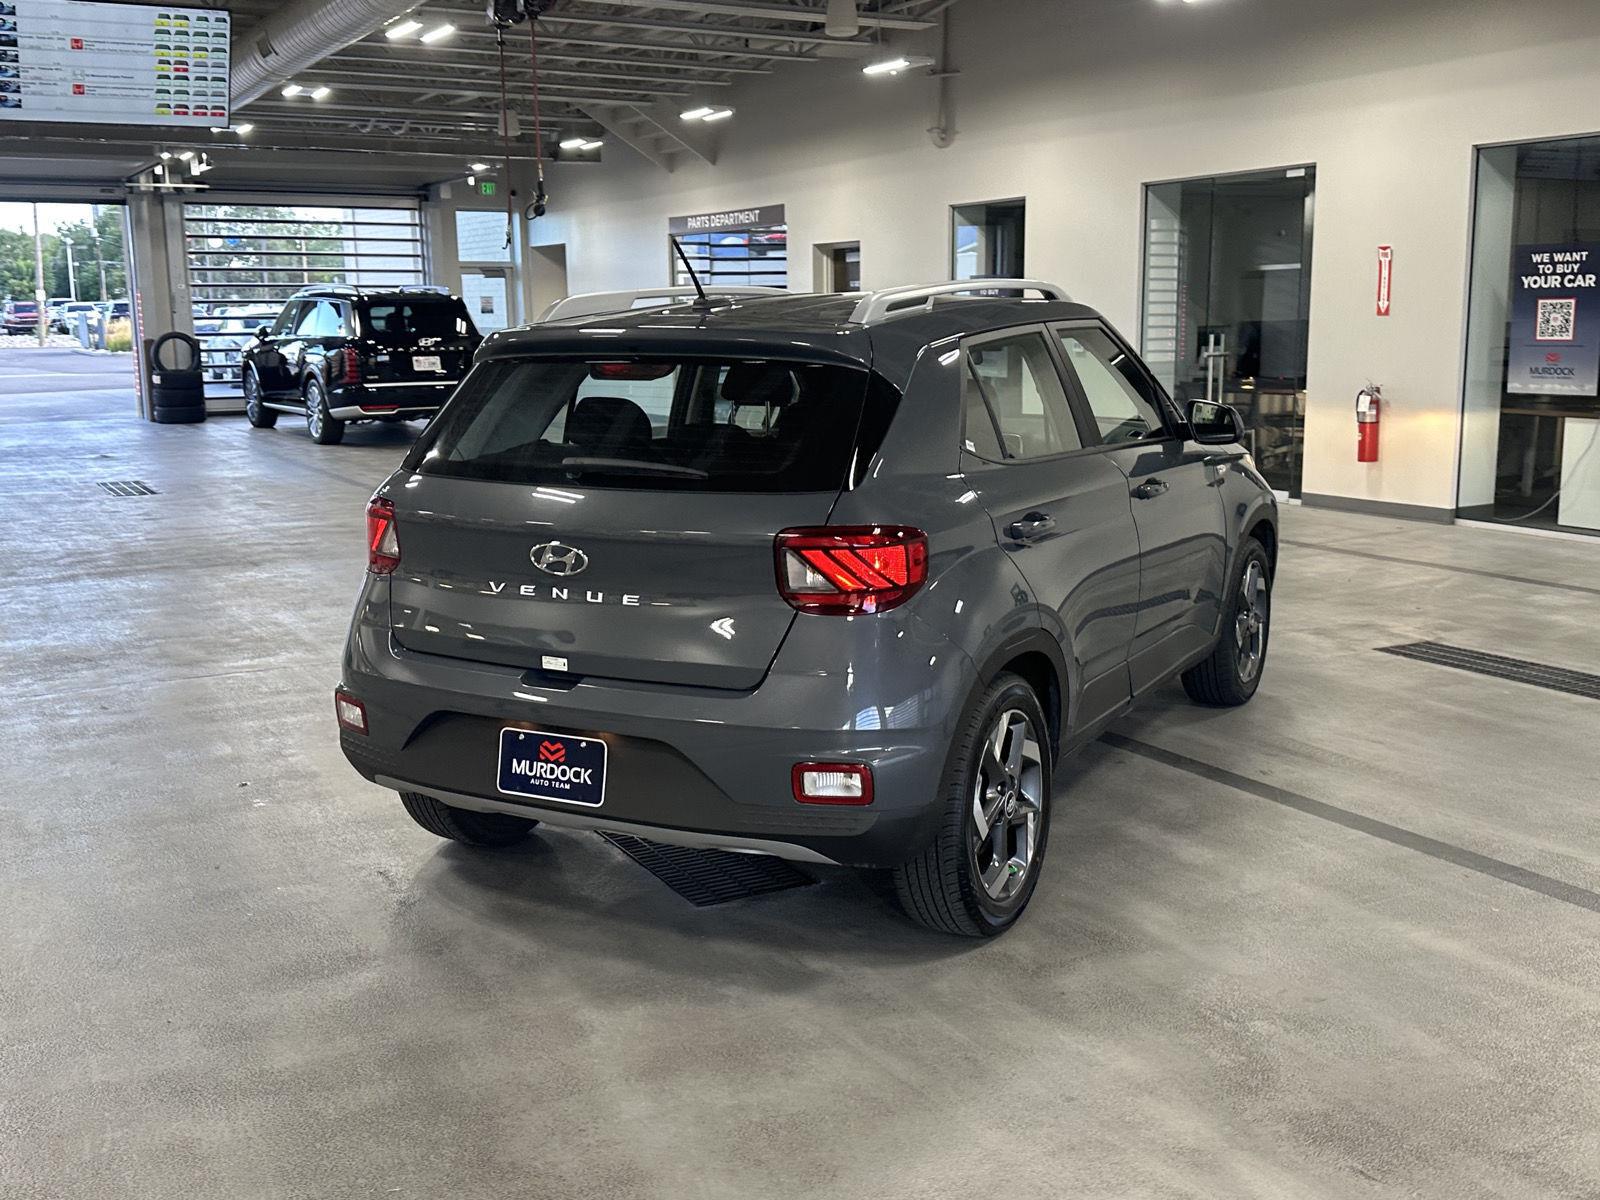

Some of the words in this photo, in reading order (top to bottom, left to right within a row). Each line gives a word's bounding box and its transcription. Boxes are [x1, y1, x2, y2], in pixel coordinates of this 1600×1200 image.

[481, 182, 496, 195] EXIT
[687, 215, 710, 229] PARTS
[710, 209, 760, 227] DEPARTMENT
[1531, 253, 1550, 263] WE
[1553, 251, 1589, 262] WANT
[1538, 264, 1553, 274] TO
[1556, 263, 1581, 273] BUY
[1521, 275, 1561, 288] YOUR
[1564, 274, 1596, 288] CAR
[1529, 367, 1575, 376] MURDOCK
[489, 581, 640, 606] VENUE
[511, 758, 593, 785] MURDOCK
[530, 778, 549, 787] AUTO
[551, 781, 571, 790] TEAM
